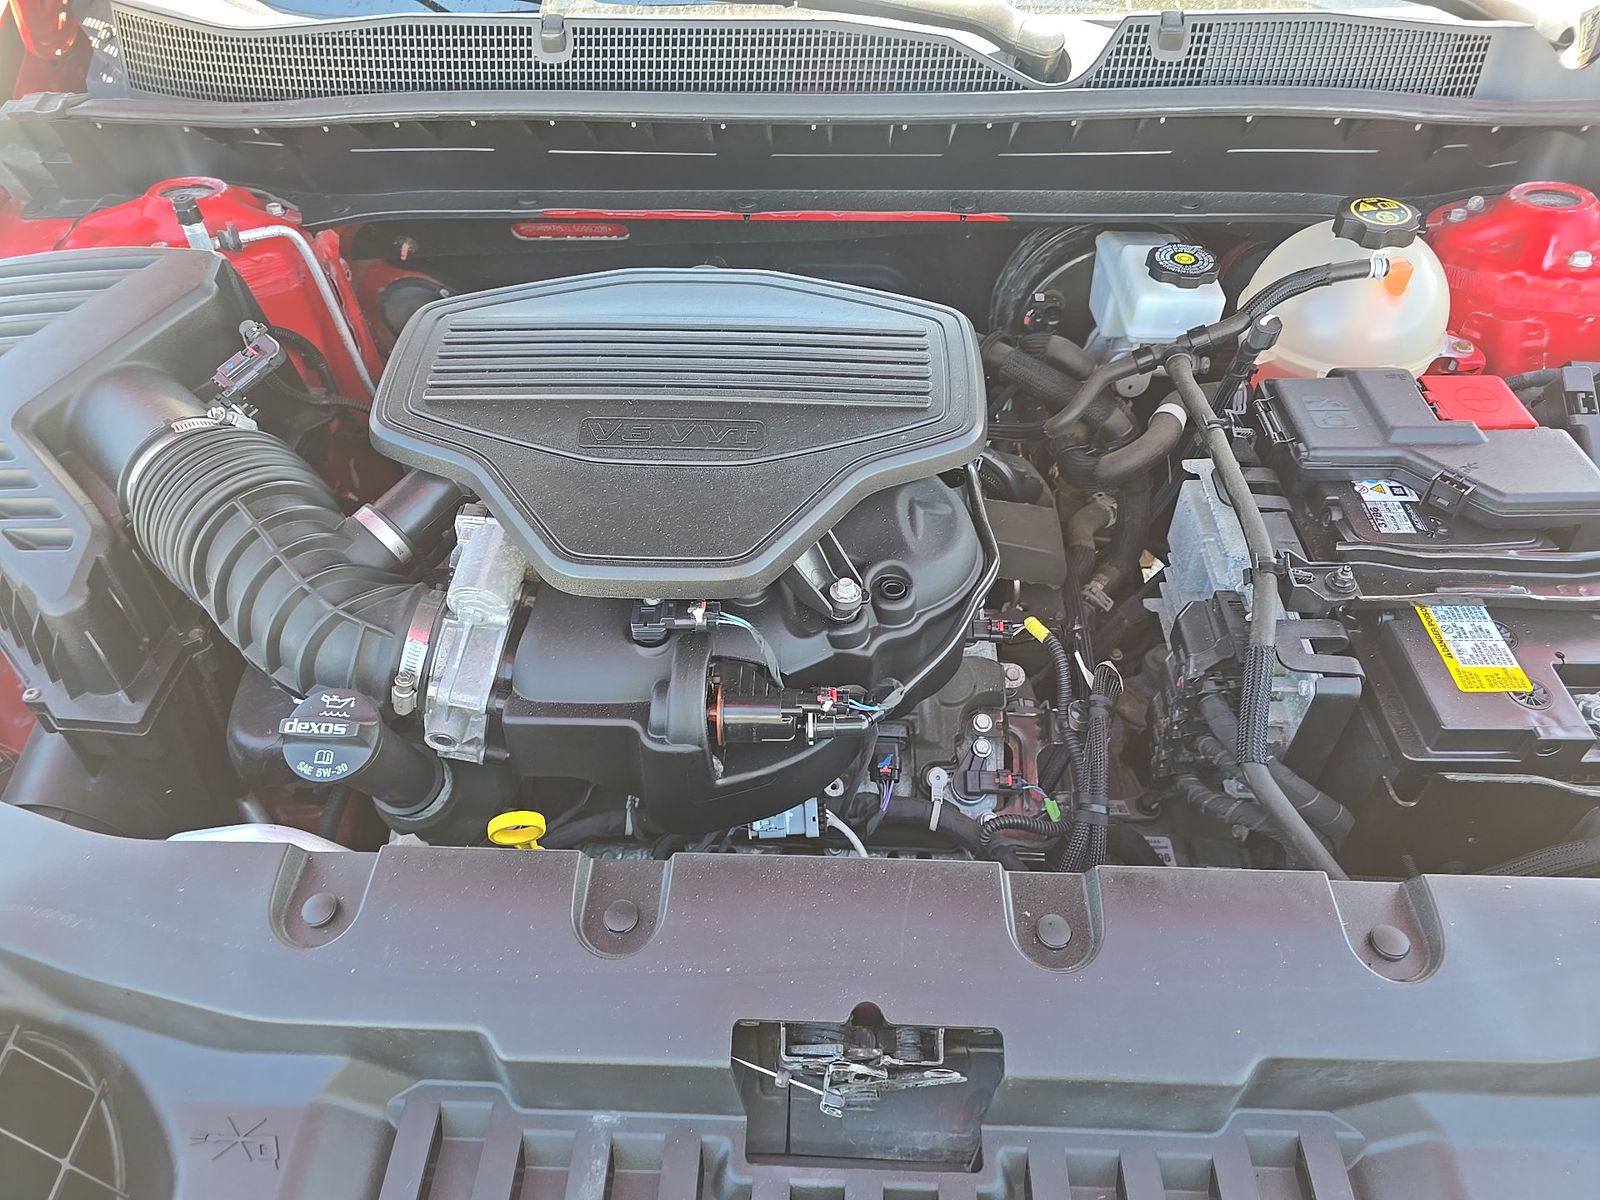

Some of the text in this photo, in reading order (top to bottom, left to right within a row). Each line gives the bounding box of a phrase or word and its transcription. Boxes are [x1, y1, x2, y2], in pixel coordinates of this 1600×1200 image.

[587, 423, 759, 444] V6 VVT
[1370, 506, 1388, 529] 3786
[283, 718, 347, 735] dexos
[297, 761, 349, 778] SAE 5W-30
